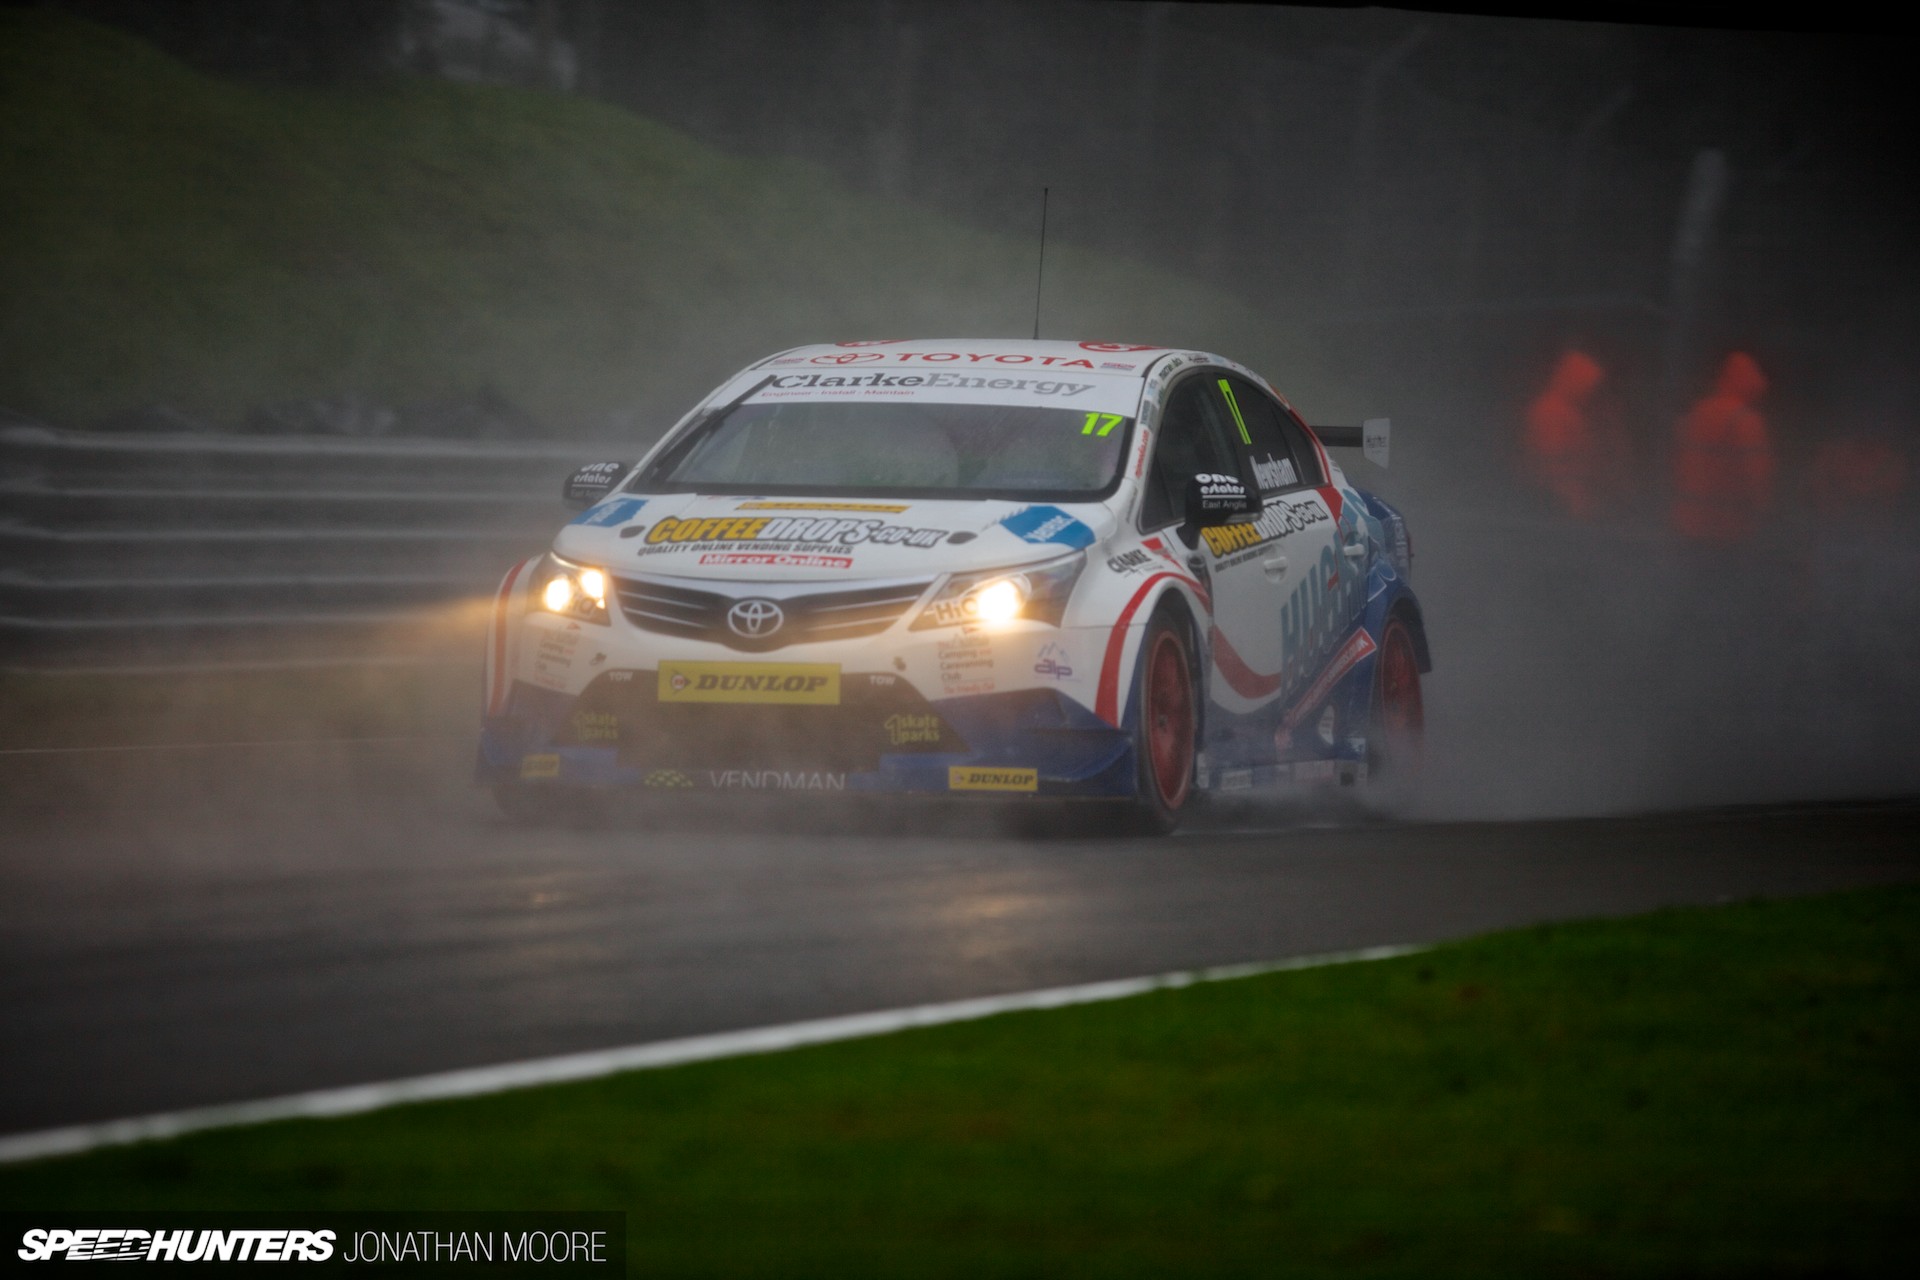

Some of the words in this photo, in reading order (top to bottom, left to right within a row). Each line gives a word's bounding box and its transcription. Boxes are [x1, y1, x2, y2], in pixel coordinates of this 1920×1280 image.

[896, 353, 1095, 369] TOYOTA
[772, 373, 1096, 396] ClarkeEnergy
[1081, 412, 1123, 437] 17
[573, 472, 612, 484] estates
[1200, 484, 1245, 495] estates
[1203, 500, 1221, 509] East
[1223, 500, 1248, 511] Anglia
[637, 543, 688, 556] QUALITY
[690, 542, 734, 552] ONLINE
[737, 542, 791, 552] VENDING
[793, 543, 854, 555] SUPPLIES
[703, 554, 770, 565] Mirror
[774, 555, 849, 568] Online
[608, 671, 633, 681] TOW
[694, 674, 828, 692] DUNLOP
[870, 675, 896, 687] TOW
[709, 769, 846, 791] VENDMAN
[968, 773, 1034, 785] DUNLOP
